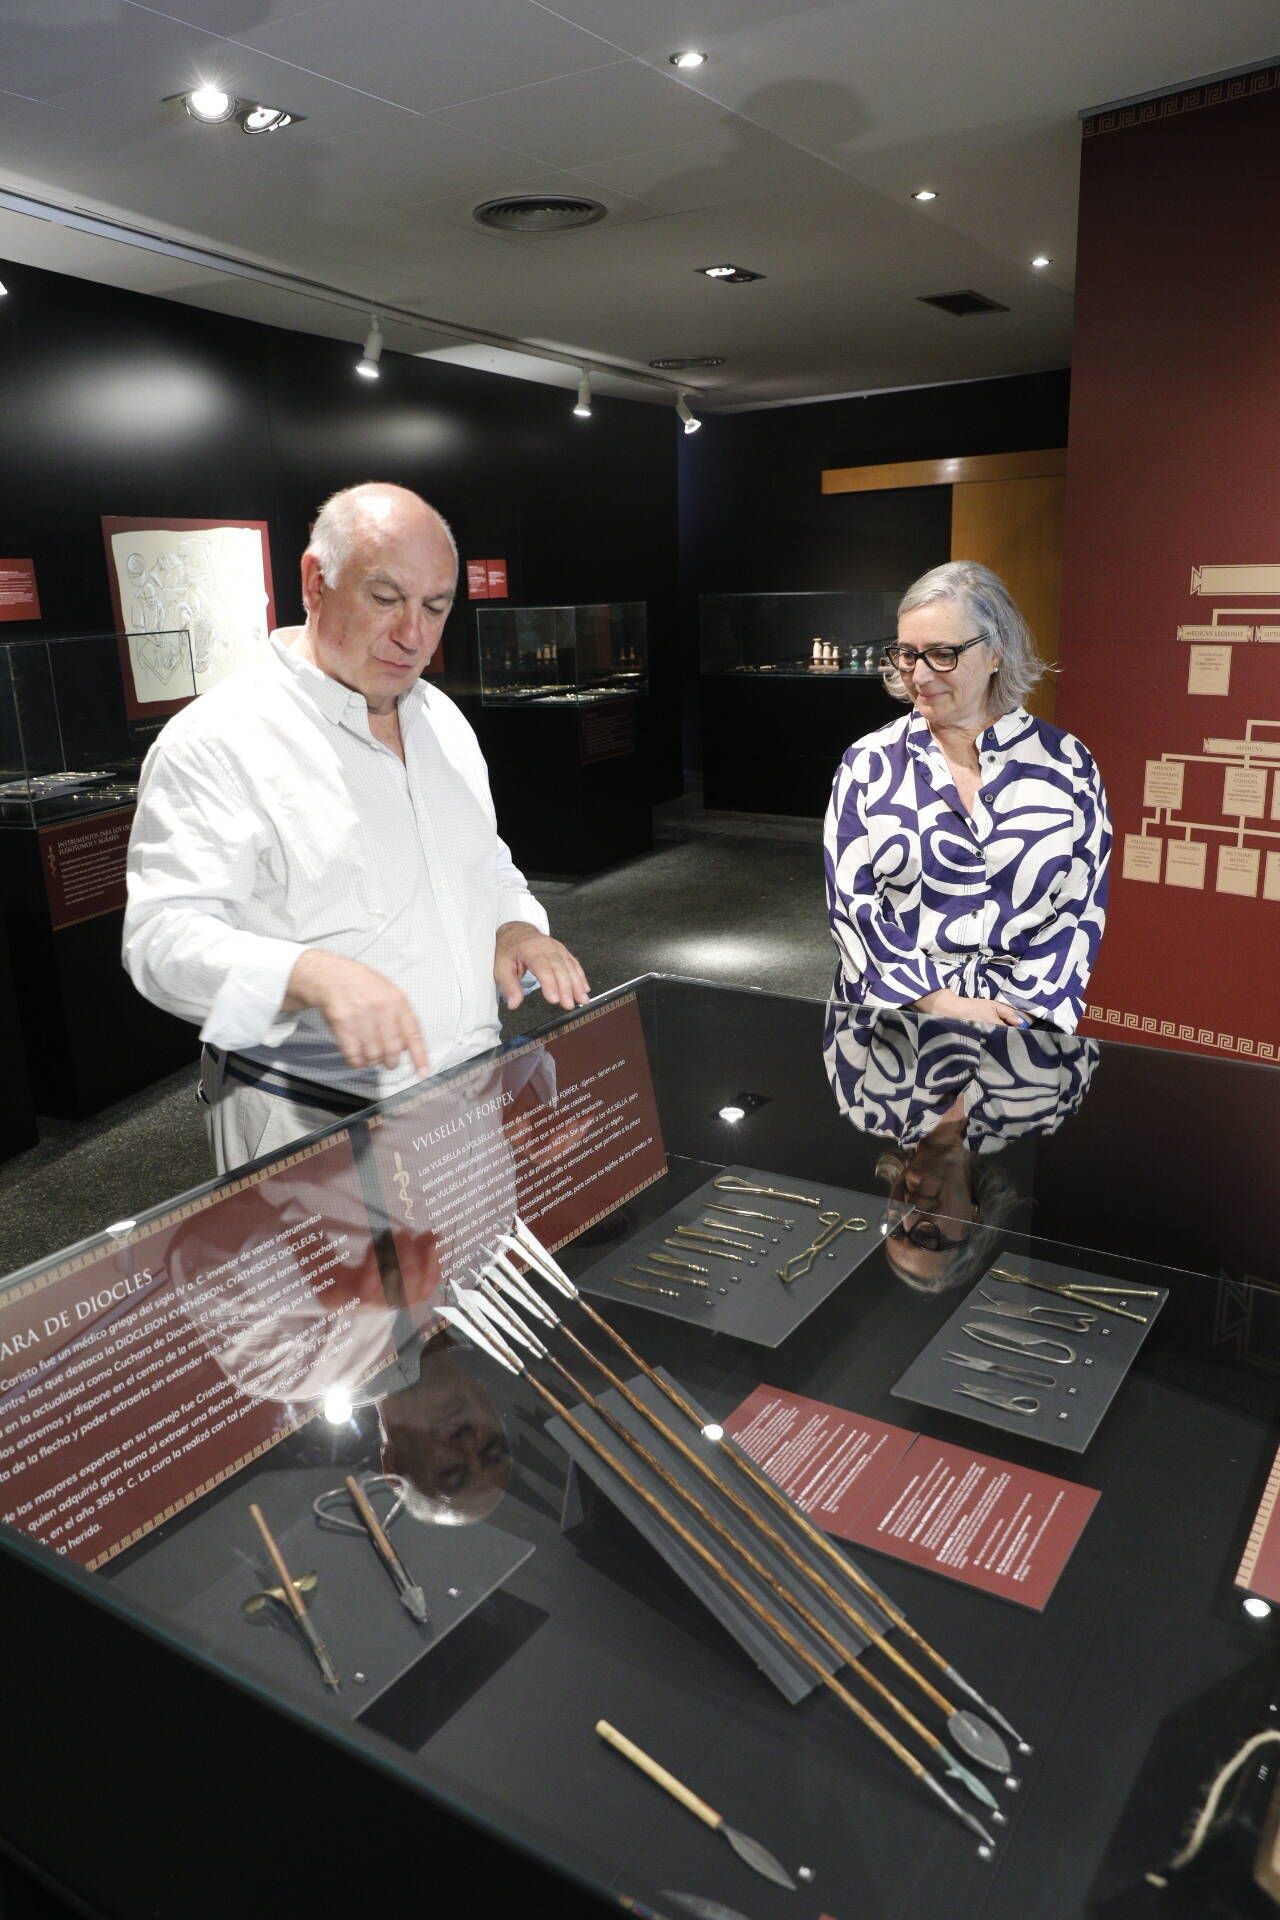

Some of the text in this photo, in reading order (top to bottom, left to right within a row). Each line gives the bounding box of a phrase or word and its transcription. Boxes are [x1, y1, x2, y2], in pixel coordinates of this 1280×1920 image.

[465, 1110, 474, 1124] Y
[0, 1267, 154, 1360] ARA DE DIOCLES
[0, 1366, 38, 1392] Caristo
[38, 1356, 56, 1370] fue
[57, 1348, 71, 1360] un
[72, 1329, 107, 1352] médico
[108, 1312, 138, 1335] griego
[138, 1302, 153, 1317] del
[154, 1292, 175, 1308] siglo
[5, 1421, 19, 1434] en
[19, 1414, 31, 1426] la
[32, 1381, 85, 1419] actualidad
[86, 1368, 113, 1388] como
[113, 1345, 152, 1372] Cuchara
[152, 1338, 165, 1350] de
[298, 1256, 310, 1266] de
[26, 1386, 43, 1400] los
[44, 1374, 64, 1392] que
[64, 1352, 104, 1378] destaca
[104, 1346, 114, 1356] la
[115, 1315, 167, 1350] DIOCLEION
[11, 1461, 26, 1475] de
[26, 1454, 38, 1466] la
[39, 1434, 71, 1459] flecha
[72, 1430, 79, 1441] y
[79, 1412, 108, 1437] poder
[109, 1388, 150, 1417] extraerla
[150, 1378, 165, 1392] sin
[165, 1356, 203, 1383] extender
[16, 1417, 64, 1450] extremos
[65, 1412, 73, 1424] y
[72, 1390, 111, 1417] dispone
[112, 1382, 125, 1394] en
[126, 1374, 135, 1386] el
[135, 1359, 164, 1380] centro
[164, 1351, 177, 1363] de
[177, 1346, 187, 1356] la
[16, 1501, 33, 1517] los
[34, 1473, 78, 1506] mayores
[78, 1446, 121, 1478] expertos
[121, 1438, 134, 1451] en
[134, 1430, 147, 1443] su
[147, 1409, 180, 1435] manejo
[180, 1400, 196, 1414] fue
[27, 1508, 56, 1535] quien
[58, 1479, 99, 1513] adquirió
[99, 1466, 122, 1488] gran
[122, 1450, 148, 1471] fama
[149, 1442, 158, 1455] al
[159, 1424, 190, 1448] extraer
[190, 1412, 208, 1428] una
[207, 1396, 233, 1417] flecha
[49, 1526, 63, 1540] en
[64, 1516, 74, 1531] el
[75, 1505, 95, 1524] año
[95, 1489, 116, 1510] 355
[137, 1469, 150, 1482] La
[151, 1455, 172, 1474] cura
[171, 1448, 181, 1460] la
[210, 1419, 226, 1434] con
[226, 1409, 238, 1424] tal
[67, 1524, 103, 1550] herida.
